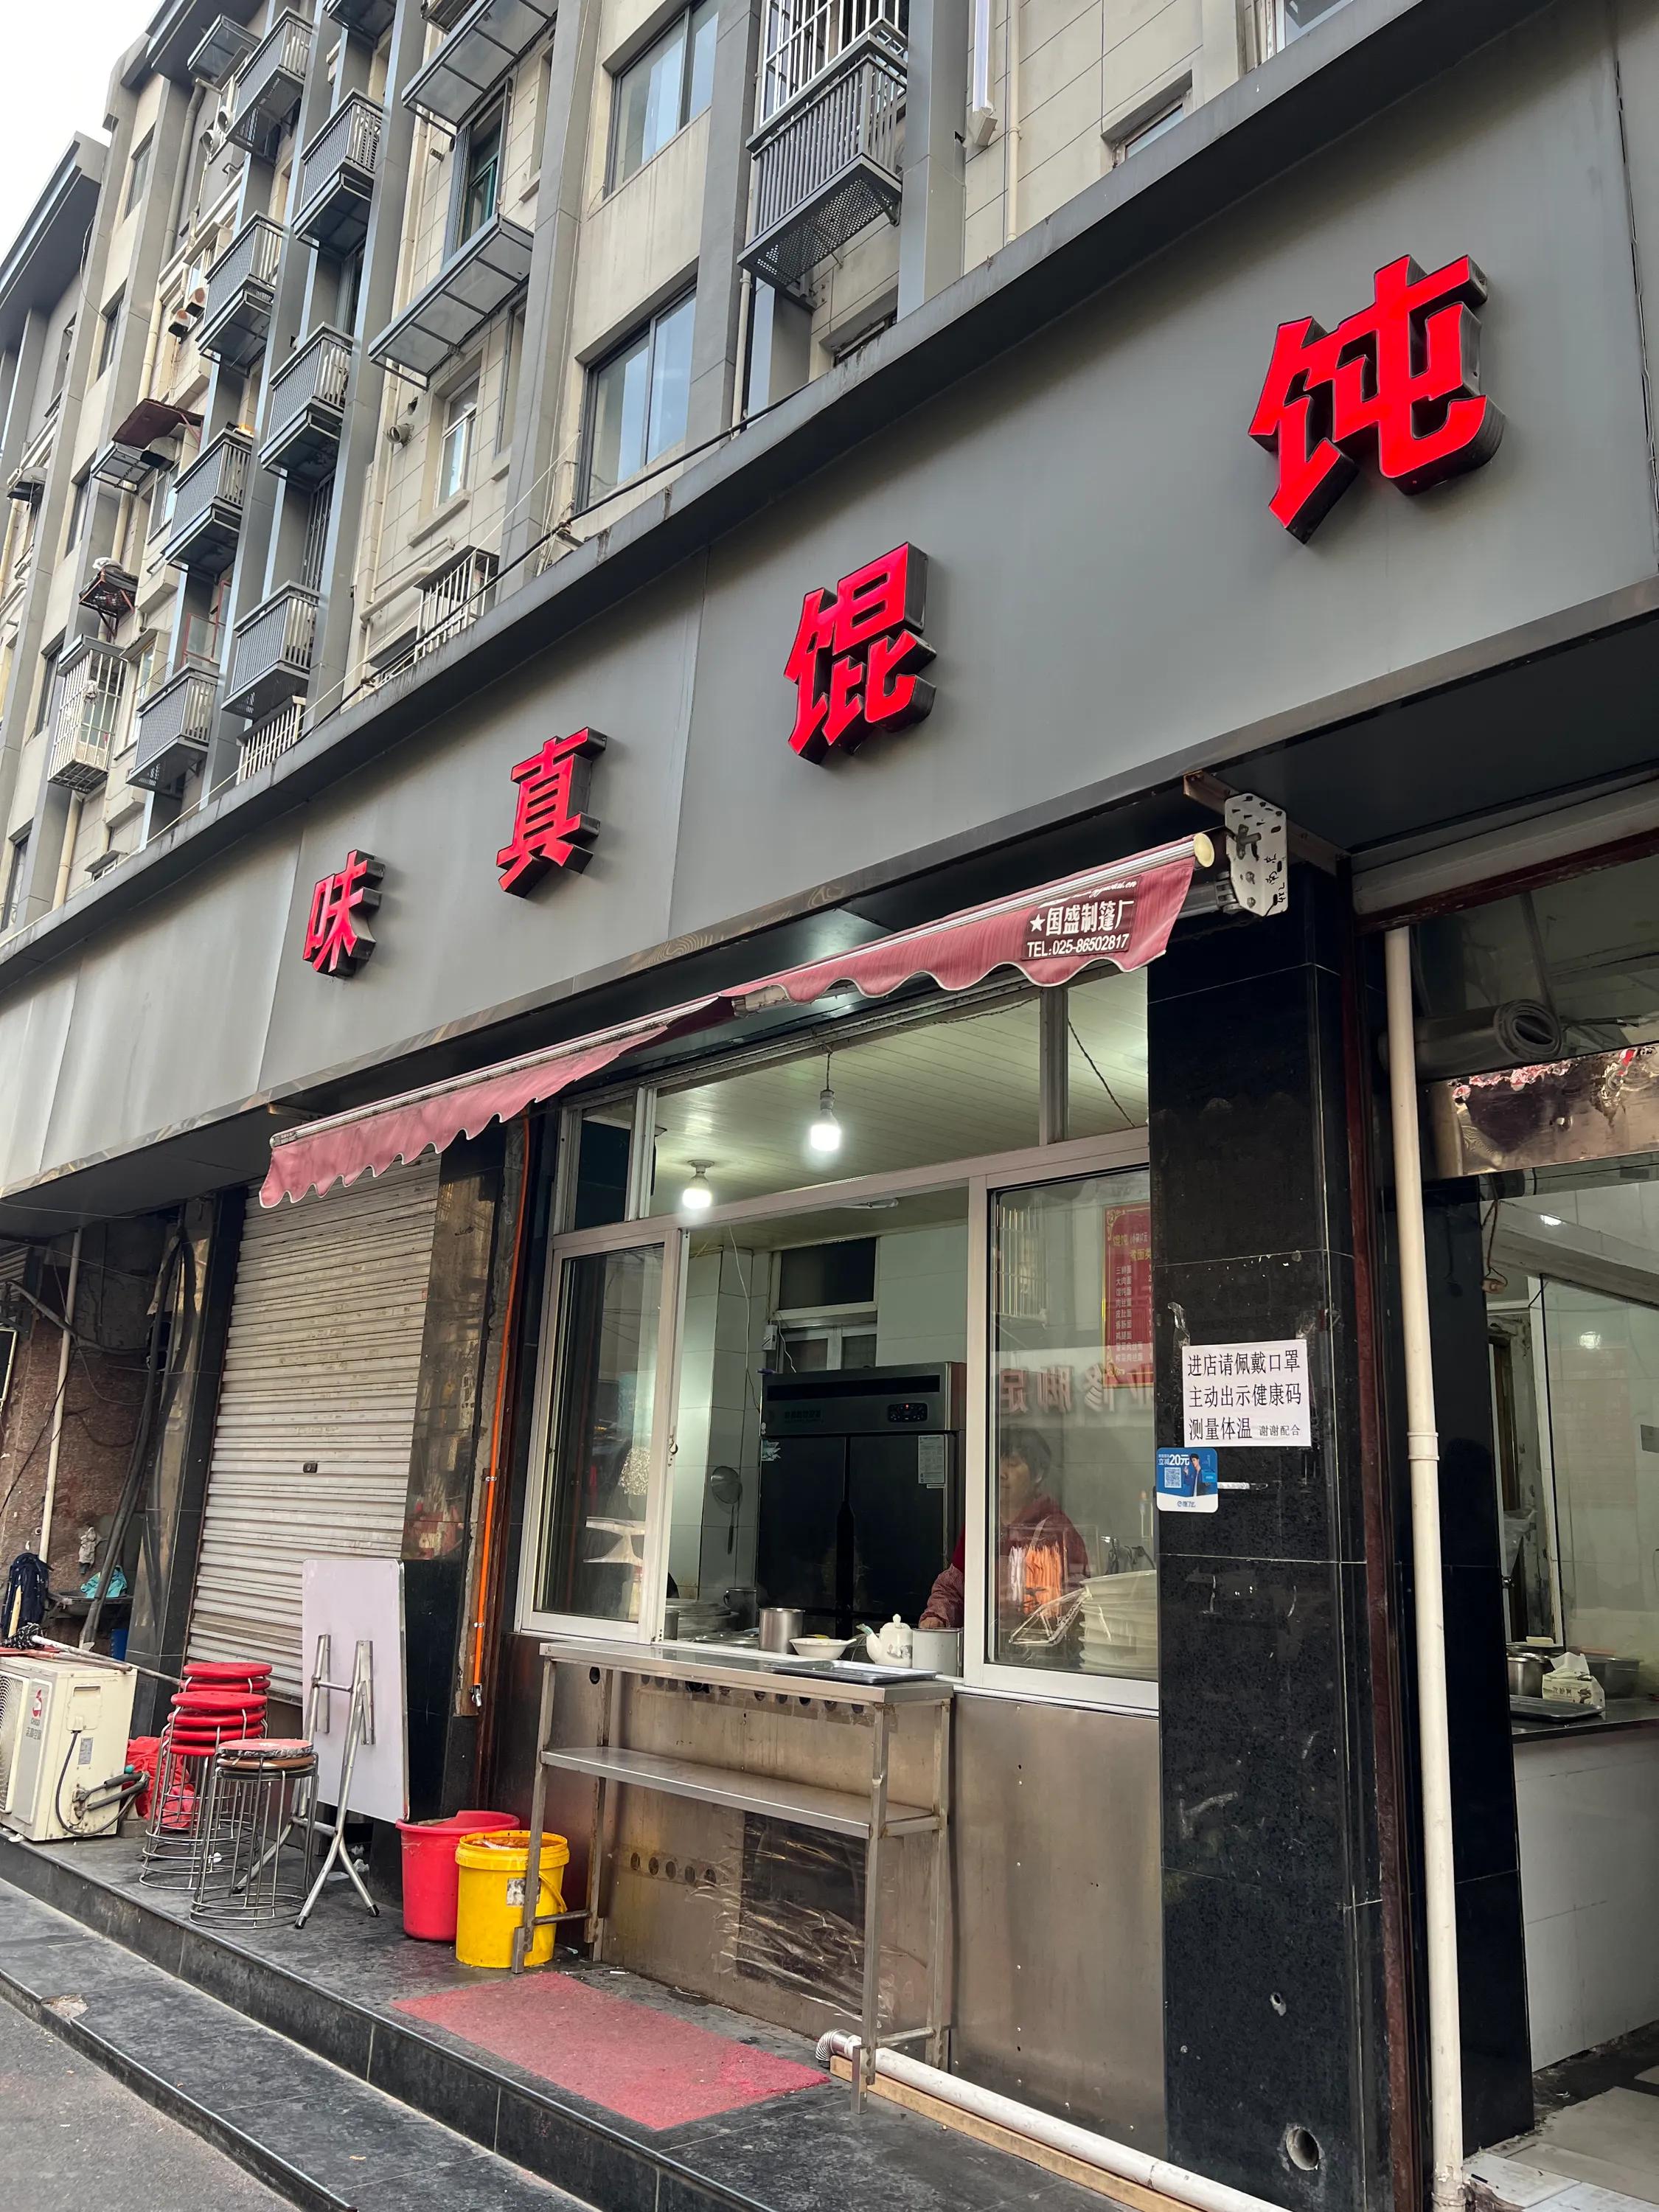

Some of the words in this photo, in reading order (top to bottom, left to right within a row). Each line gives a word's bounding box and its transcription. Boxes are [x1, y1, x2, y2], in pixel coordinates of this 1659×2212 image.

[1046, 900, 1135, 936] 国盛制篷厂
[1026, 933, 1130, 958] TEL:025-86502817
[1187, 1349, 1300, 1377] 进店请佩戴口罩
[1189, 1382, 1301, 1408] 主动出示健康码
[1189, 1416, 1253, 1441] 测量体温
[1259, 1424, 1301, 1436] 谢谢配合
